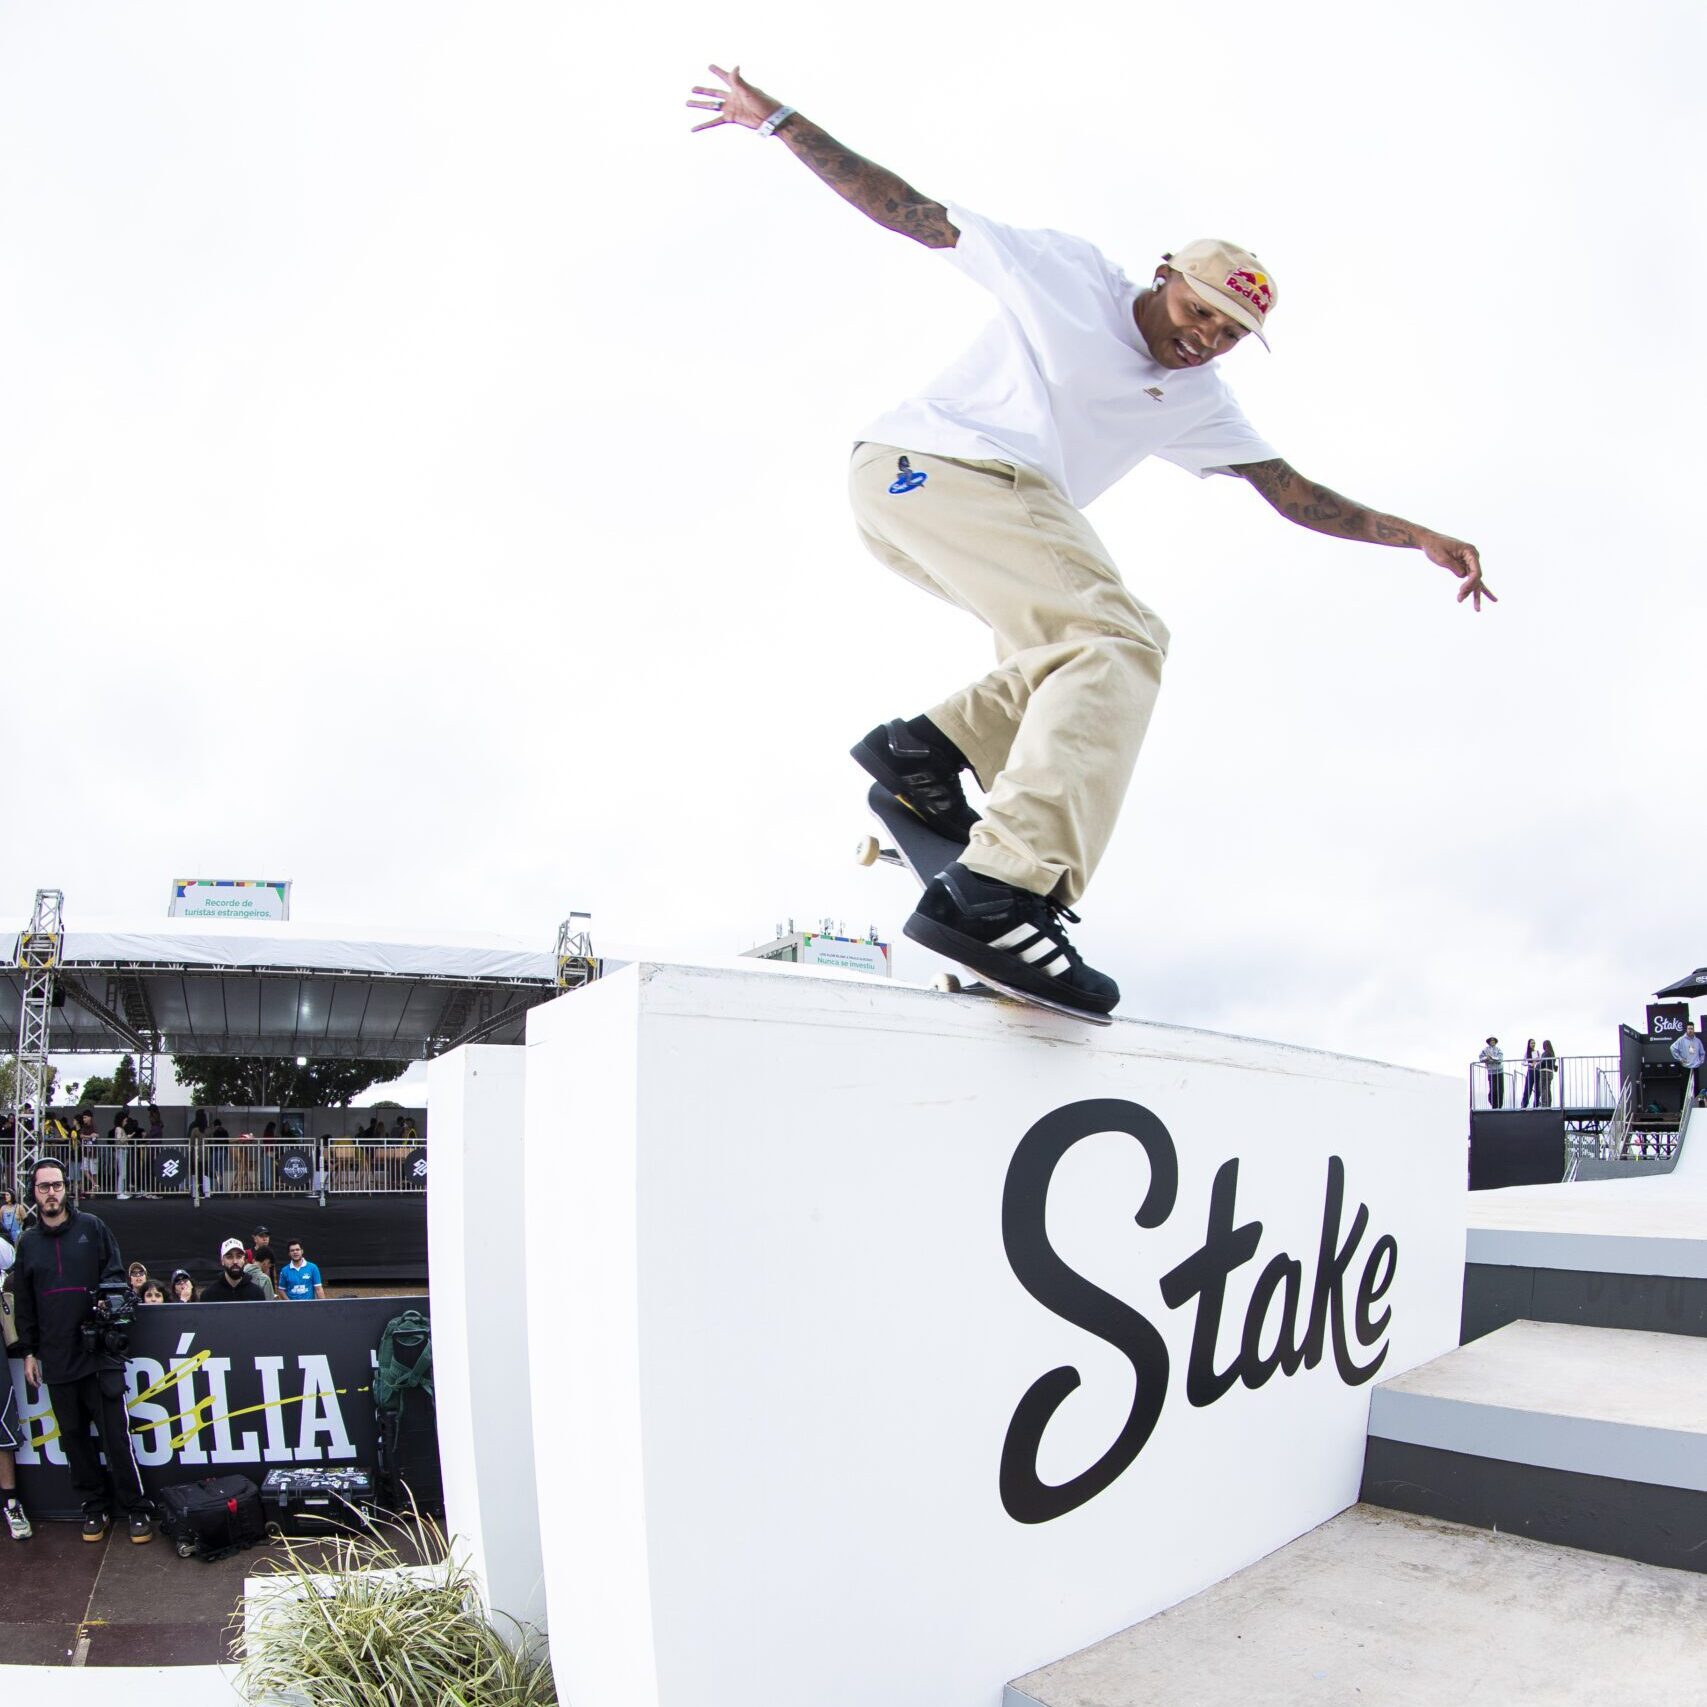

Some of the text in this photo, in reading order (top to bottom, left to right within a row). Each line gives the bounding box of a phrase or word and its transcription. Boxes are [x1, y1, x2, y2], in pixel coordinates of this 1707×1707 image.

[1225, 276, 1254, 299] Red
[205, 898, 254, 908] Recorde de
[184, 907, 272, 919] turistas estrangeiros.
[817, 956, 840, 966] Nunca
[849, 960, 876, 970] investiu
[1653, 1015, 1684, 1033] Stake
[999, 1097, 1398, 1525] Stake
[8, 1332, 357, 1467] RSÍLIA
